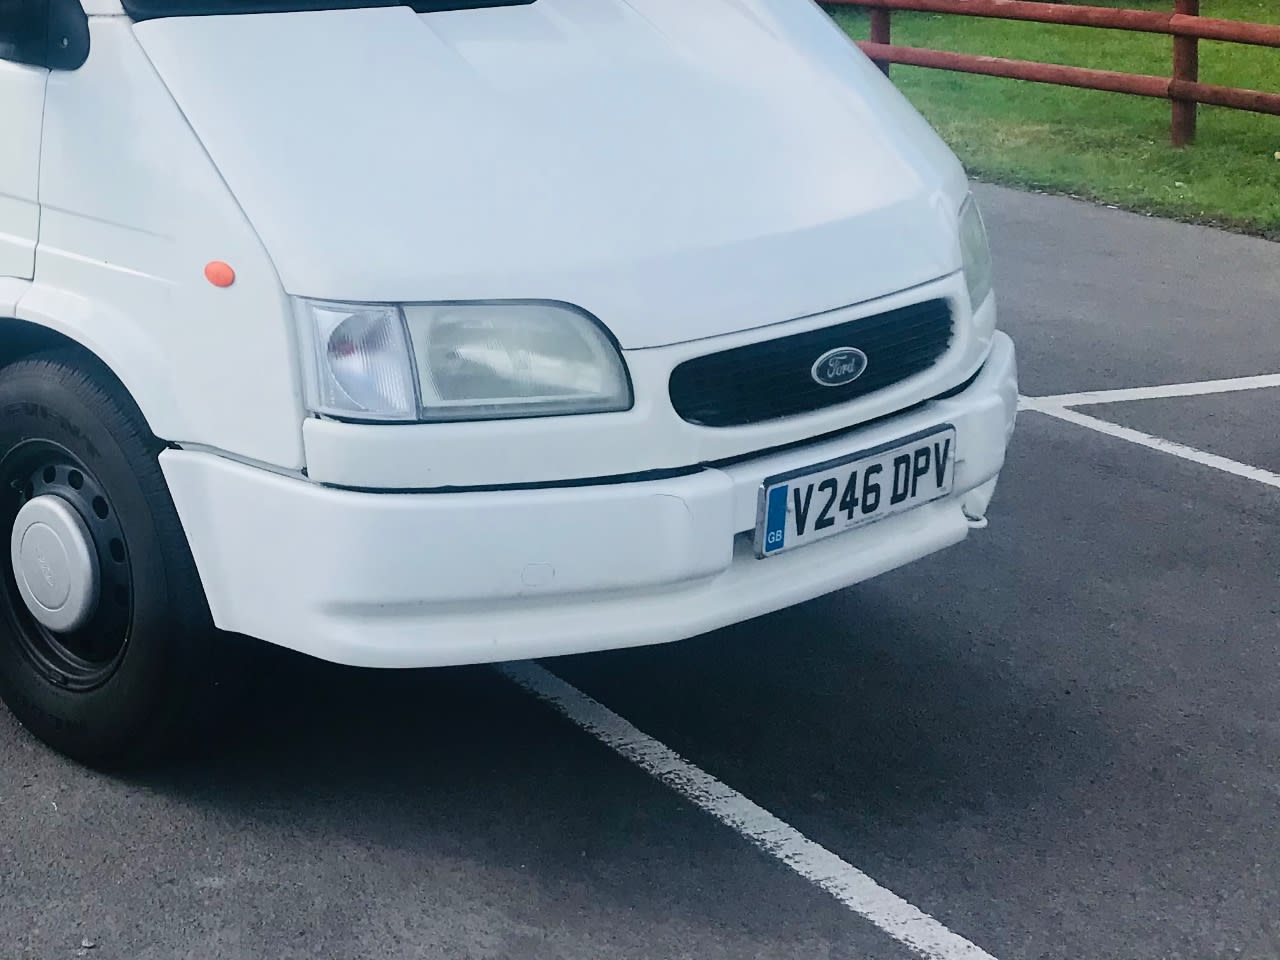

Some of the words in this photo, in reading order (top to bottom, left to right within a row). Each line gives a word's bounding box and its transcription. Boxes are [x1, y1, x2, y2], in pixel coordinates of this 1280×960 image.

[827, 355, 855, 377] Ford
[793, 463, 883, 536] V246
[890, 439, 951, 505] DPV
[767, 530, 783, 543] GB
